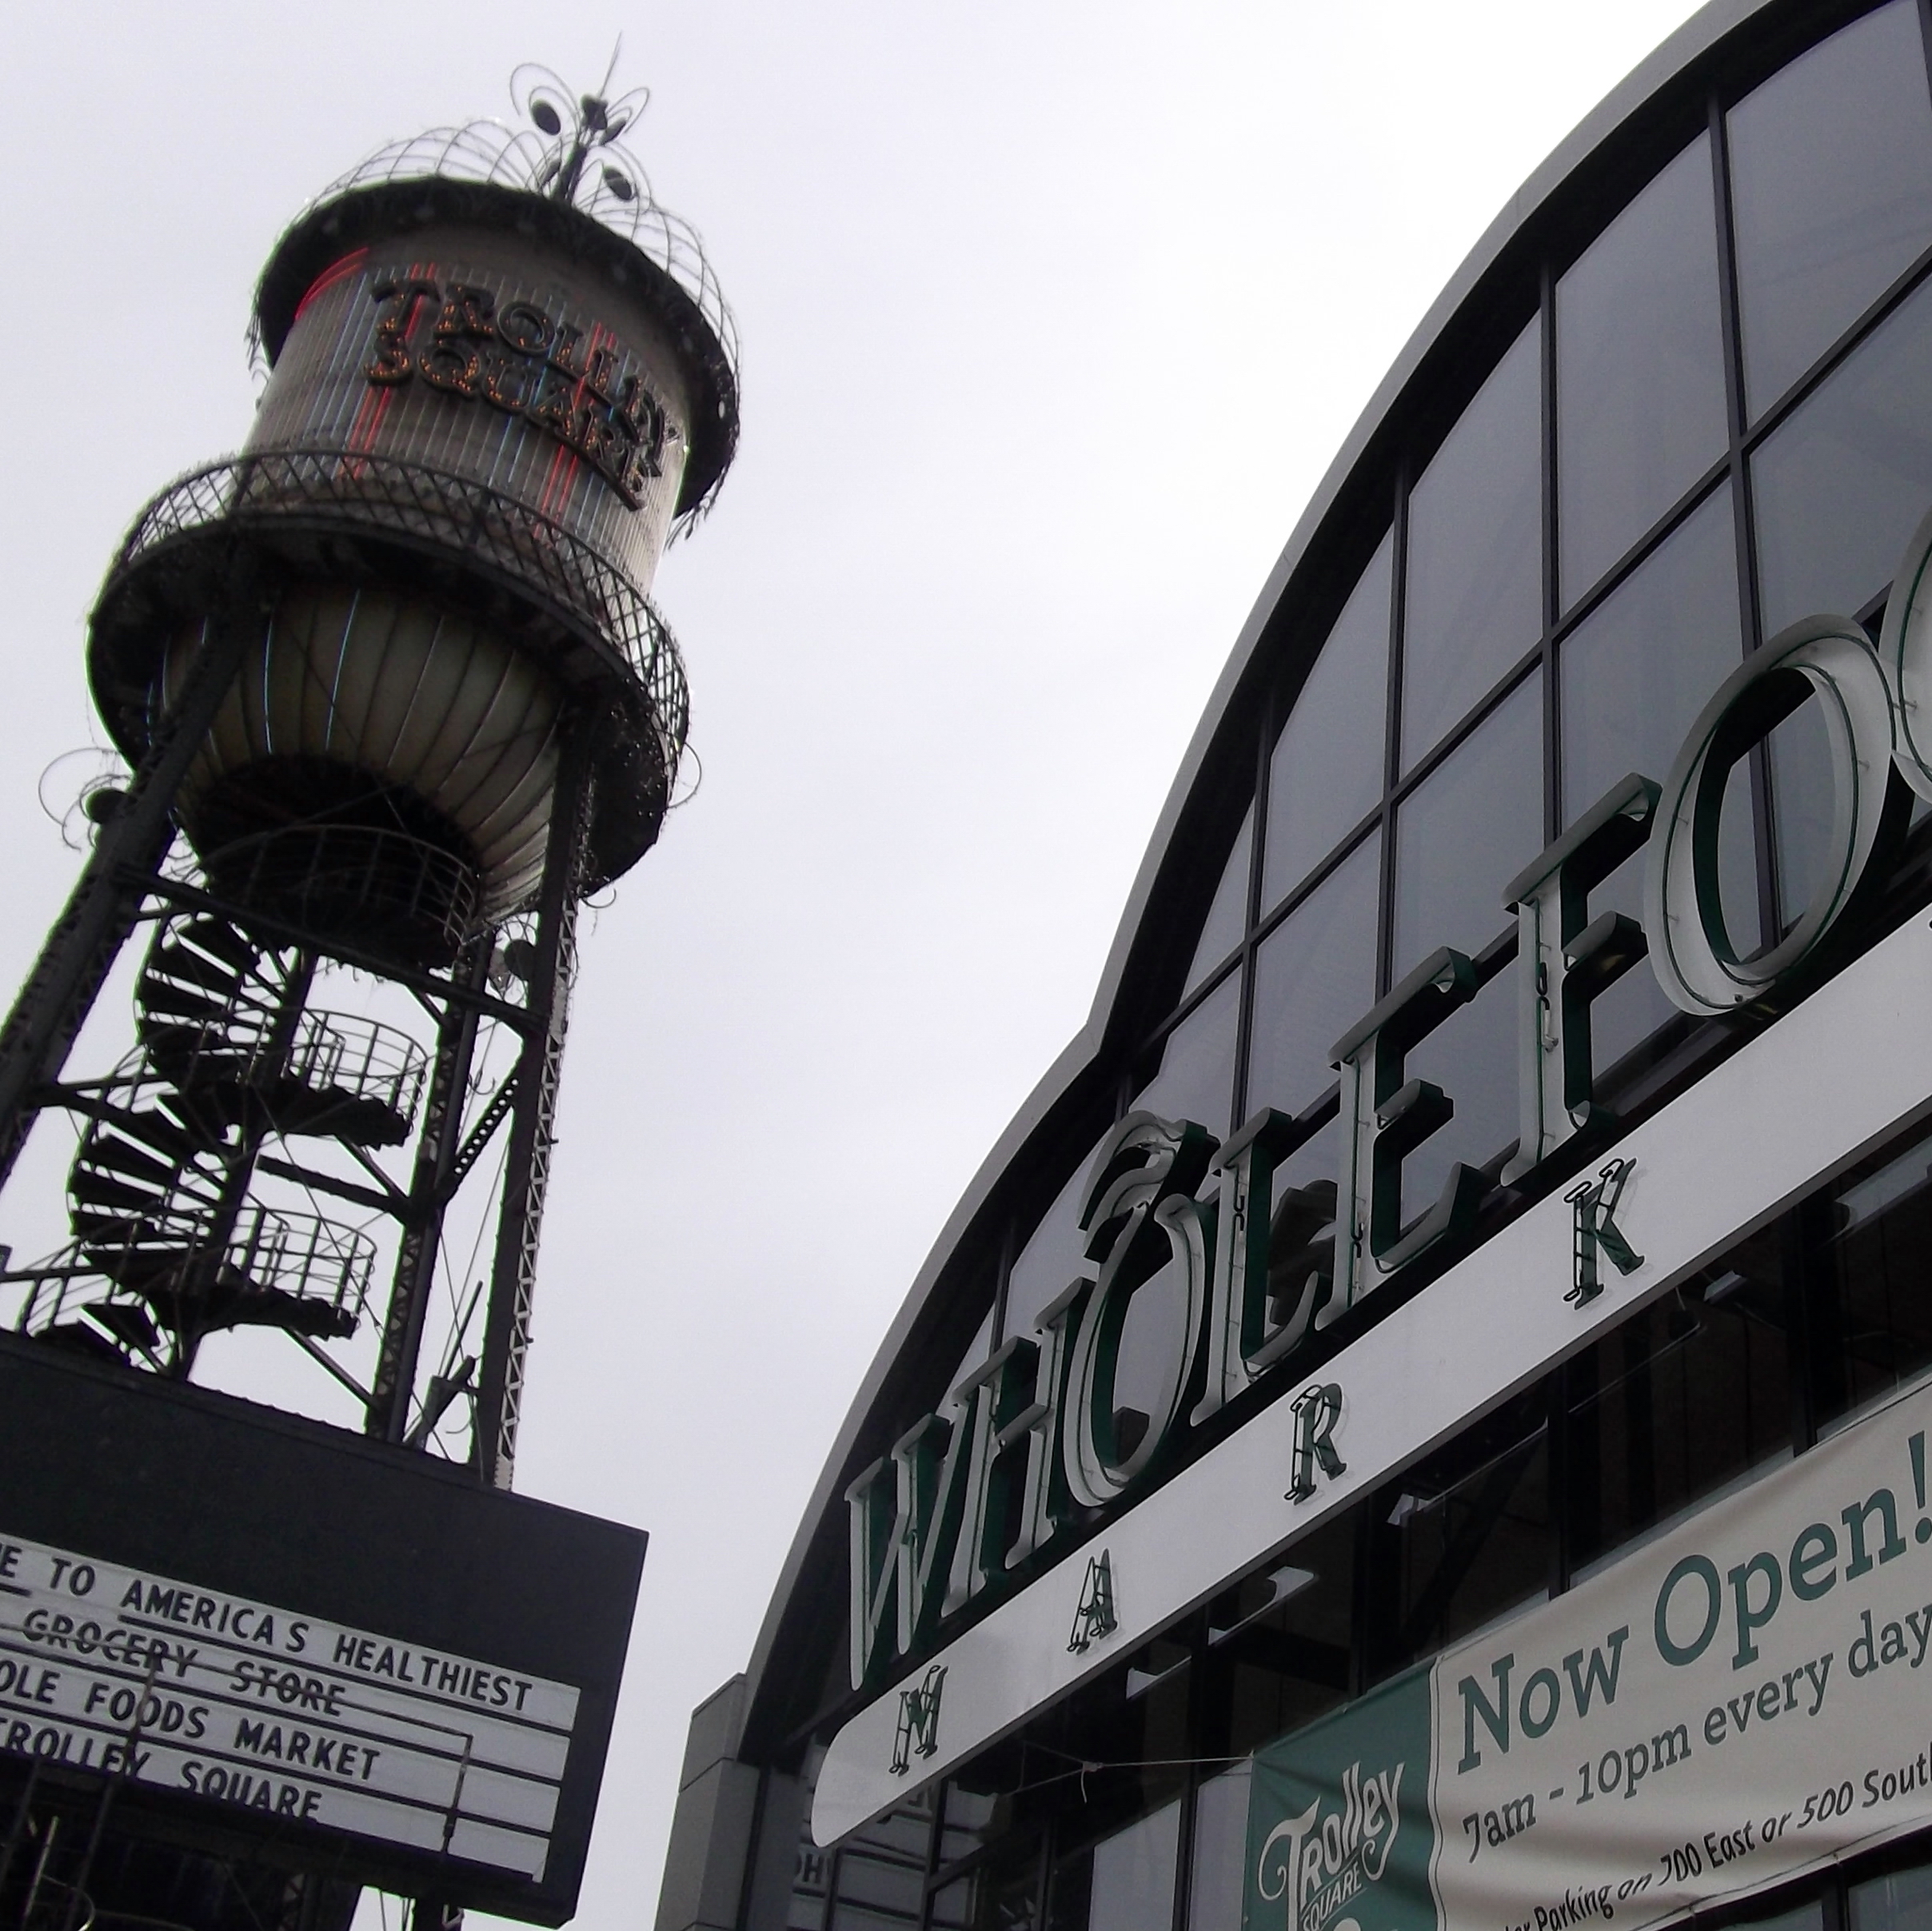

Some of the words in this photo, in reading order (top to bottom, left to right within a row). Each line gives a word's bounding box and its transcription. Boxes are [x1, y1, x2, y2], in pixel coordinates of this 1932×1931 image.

[365, 329, 646, 513] SQUARE
[844, 946, 1491, 1691] WHOLE
[1654, 1430, 1932, 1671] Open!
[22, 1609, 199, 1678] GROCERY
[230, 1660, 346, 1718] STORE
[50, 1558, 96, 1596] TO
[333, 1633, 533, 1712] HEALTHIEST
[0, 1718, 151, 1777] ROLLEY
[178, 1761, 323, 1821] SQUARE
[84, 1682, 210, 1739] FOODS
[234, 1718, 381, 1781] MARKET
[1462, 1791, 1536, 1862] 7am
[1575, 1722, 1691, 1799] 10pm
[1703, 1652, 1834, 1745] every
[1848, 1602, 1932, 1678] day
[1533, 1884, 1614, 1931] Parking
[1617, 1873, 1653, 1901] on
[1657, 1841, 1703, 1887] 700
[1703, 1820, 1756, 1869] East
[1761, 1811, 1792, 1843] or
[1796, 1781, 1854, 1829] 500
